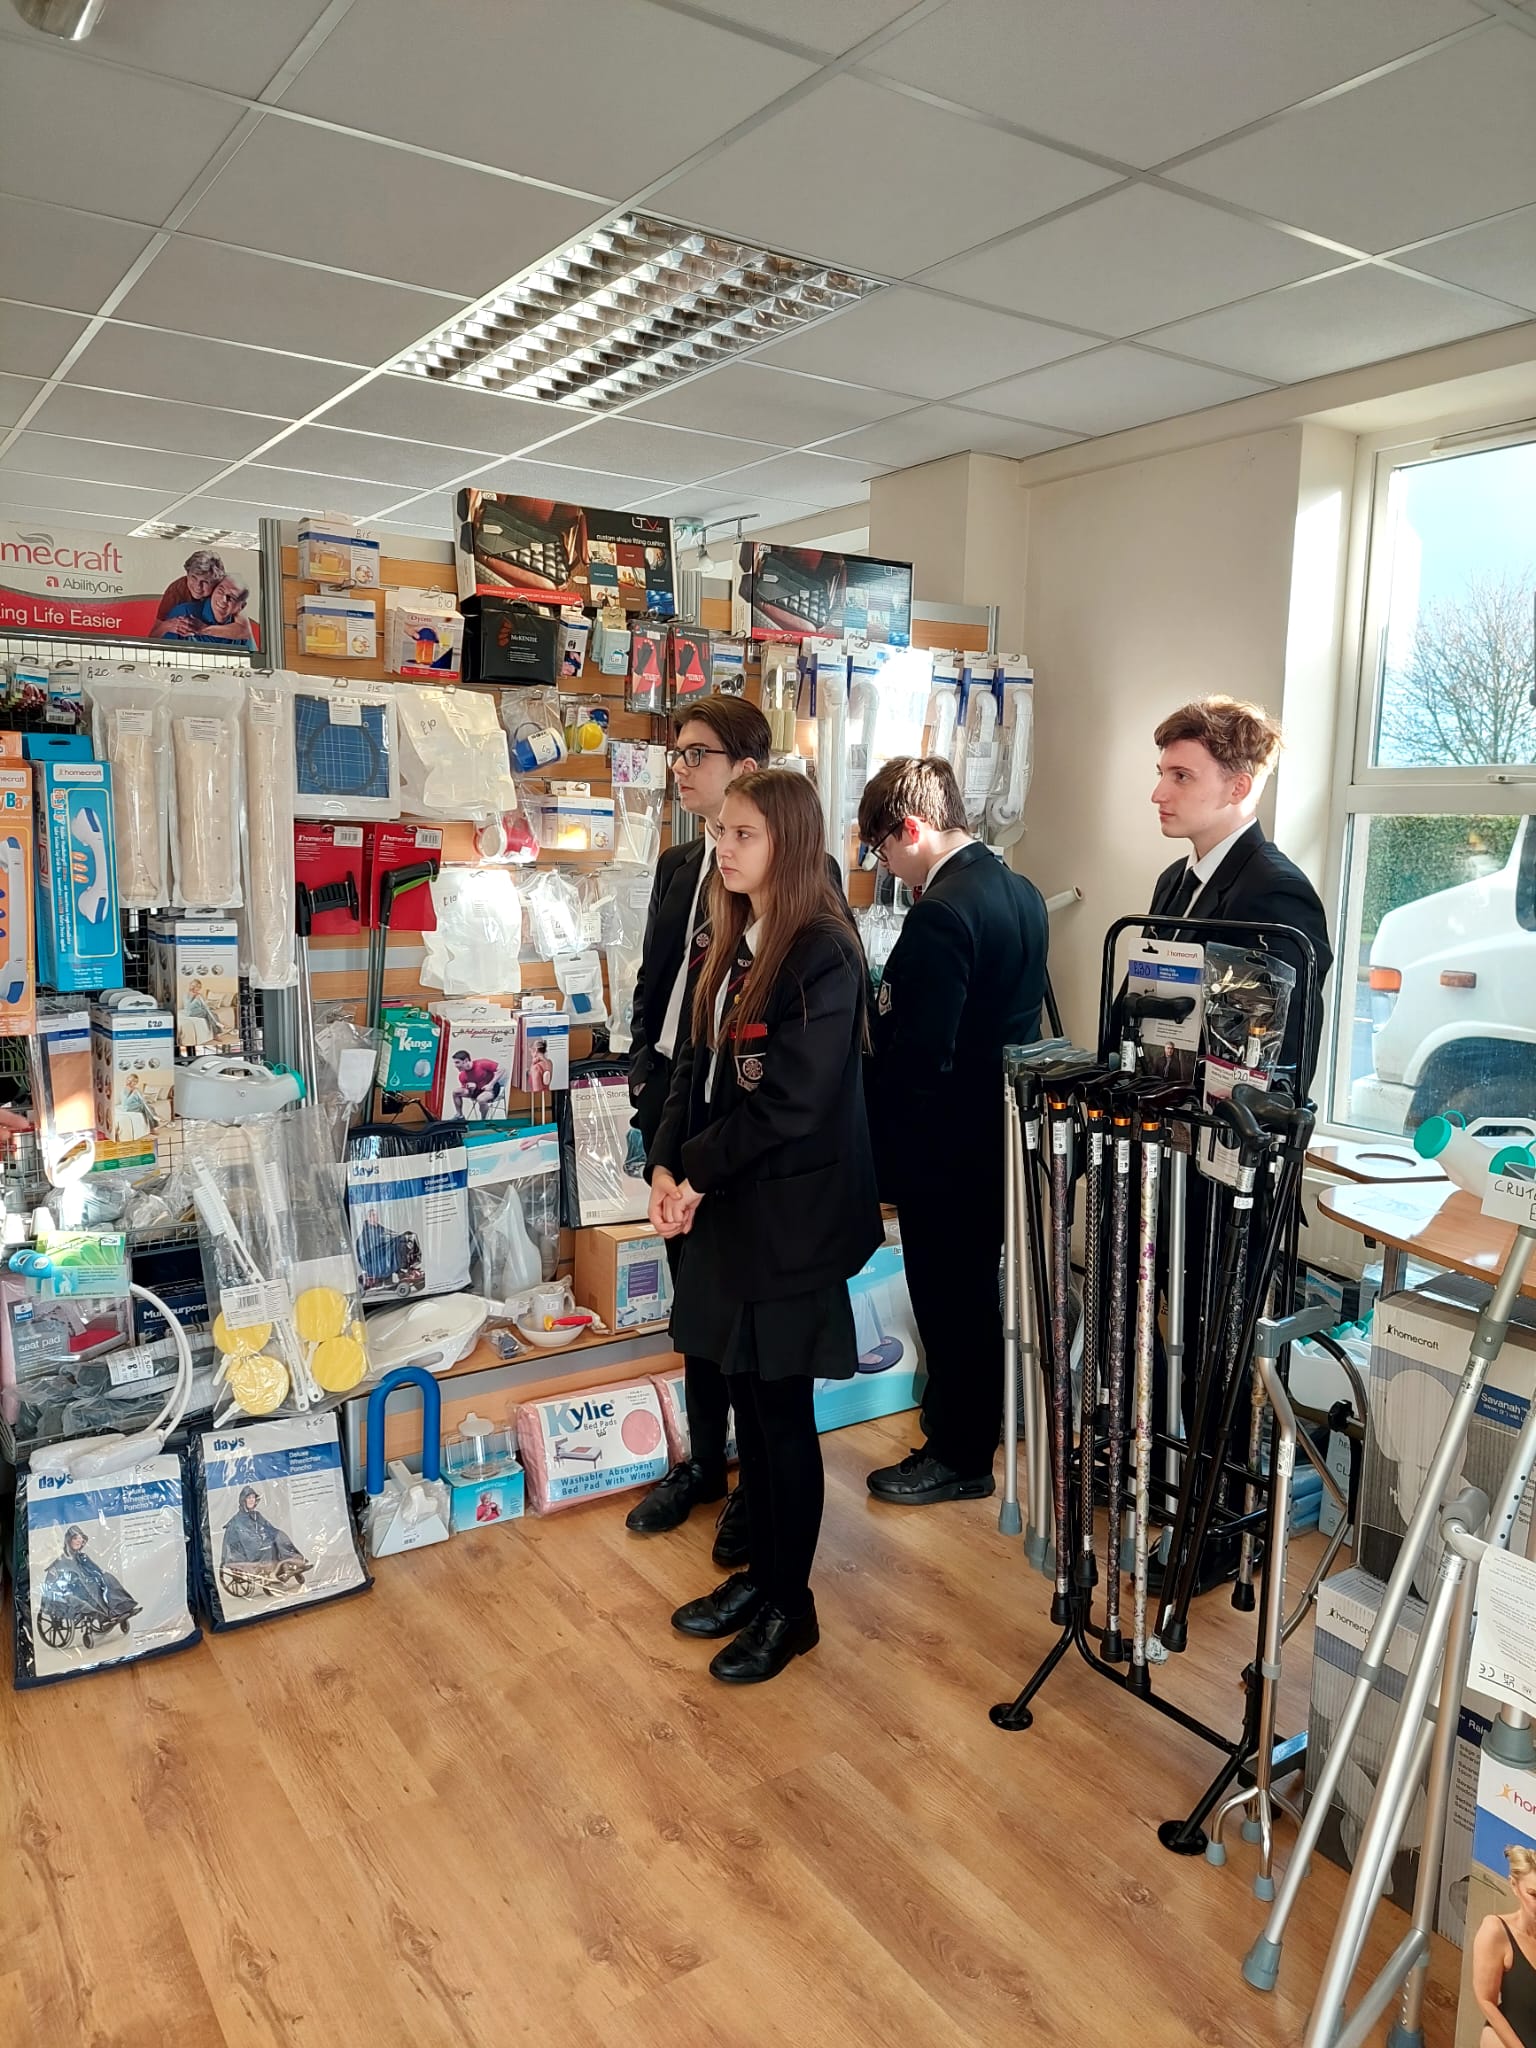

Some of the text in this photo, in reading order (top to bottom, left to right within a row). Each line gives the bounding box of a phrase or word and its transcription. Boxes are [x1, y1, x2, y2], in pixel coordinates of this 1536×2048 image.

[63, 578, 123, 594] AbilityOne
[0, 603, 123, 629] ing Life Easier
[398, 1037, 433, 1051] Kanga
[1494, 1179, 1536, 1201] CRUT
[42, 1334, 61, 1349] pad
[1393, 1327, 1439, 1350] homecraft
[584, 1419, 617, 1431] Bed Pads
[214, 1437, 246, 1452] days
[289, 1464, 313, 1473] Poncho
[560, 1461, 653, 1487] Washable Absorbent
[38, 1473, 74, 1490] days
[562, 1471, 656, 1496] Bed Pad With Wings
[1336, 1610, 1370, 1635] homecr
